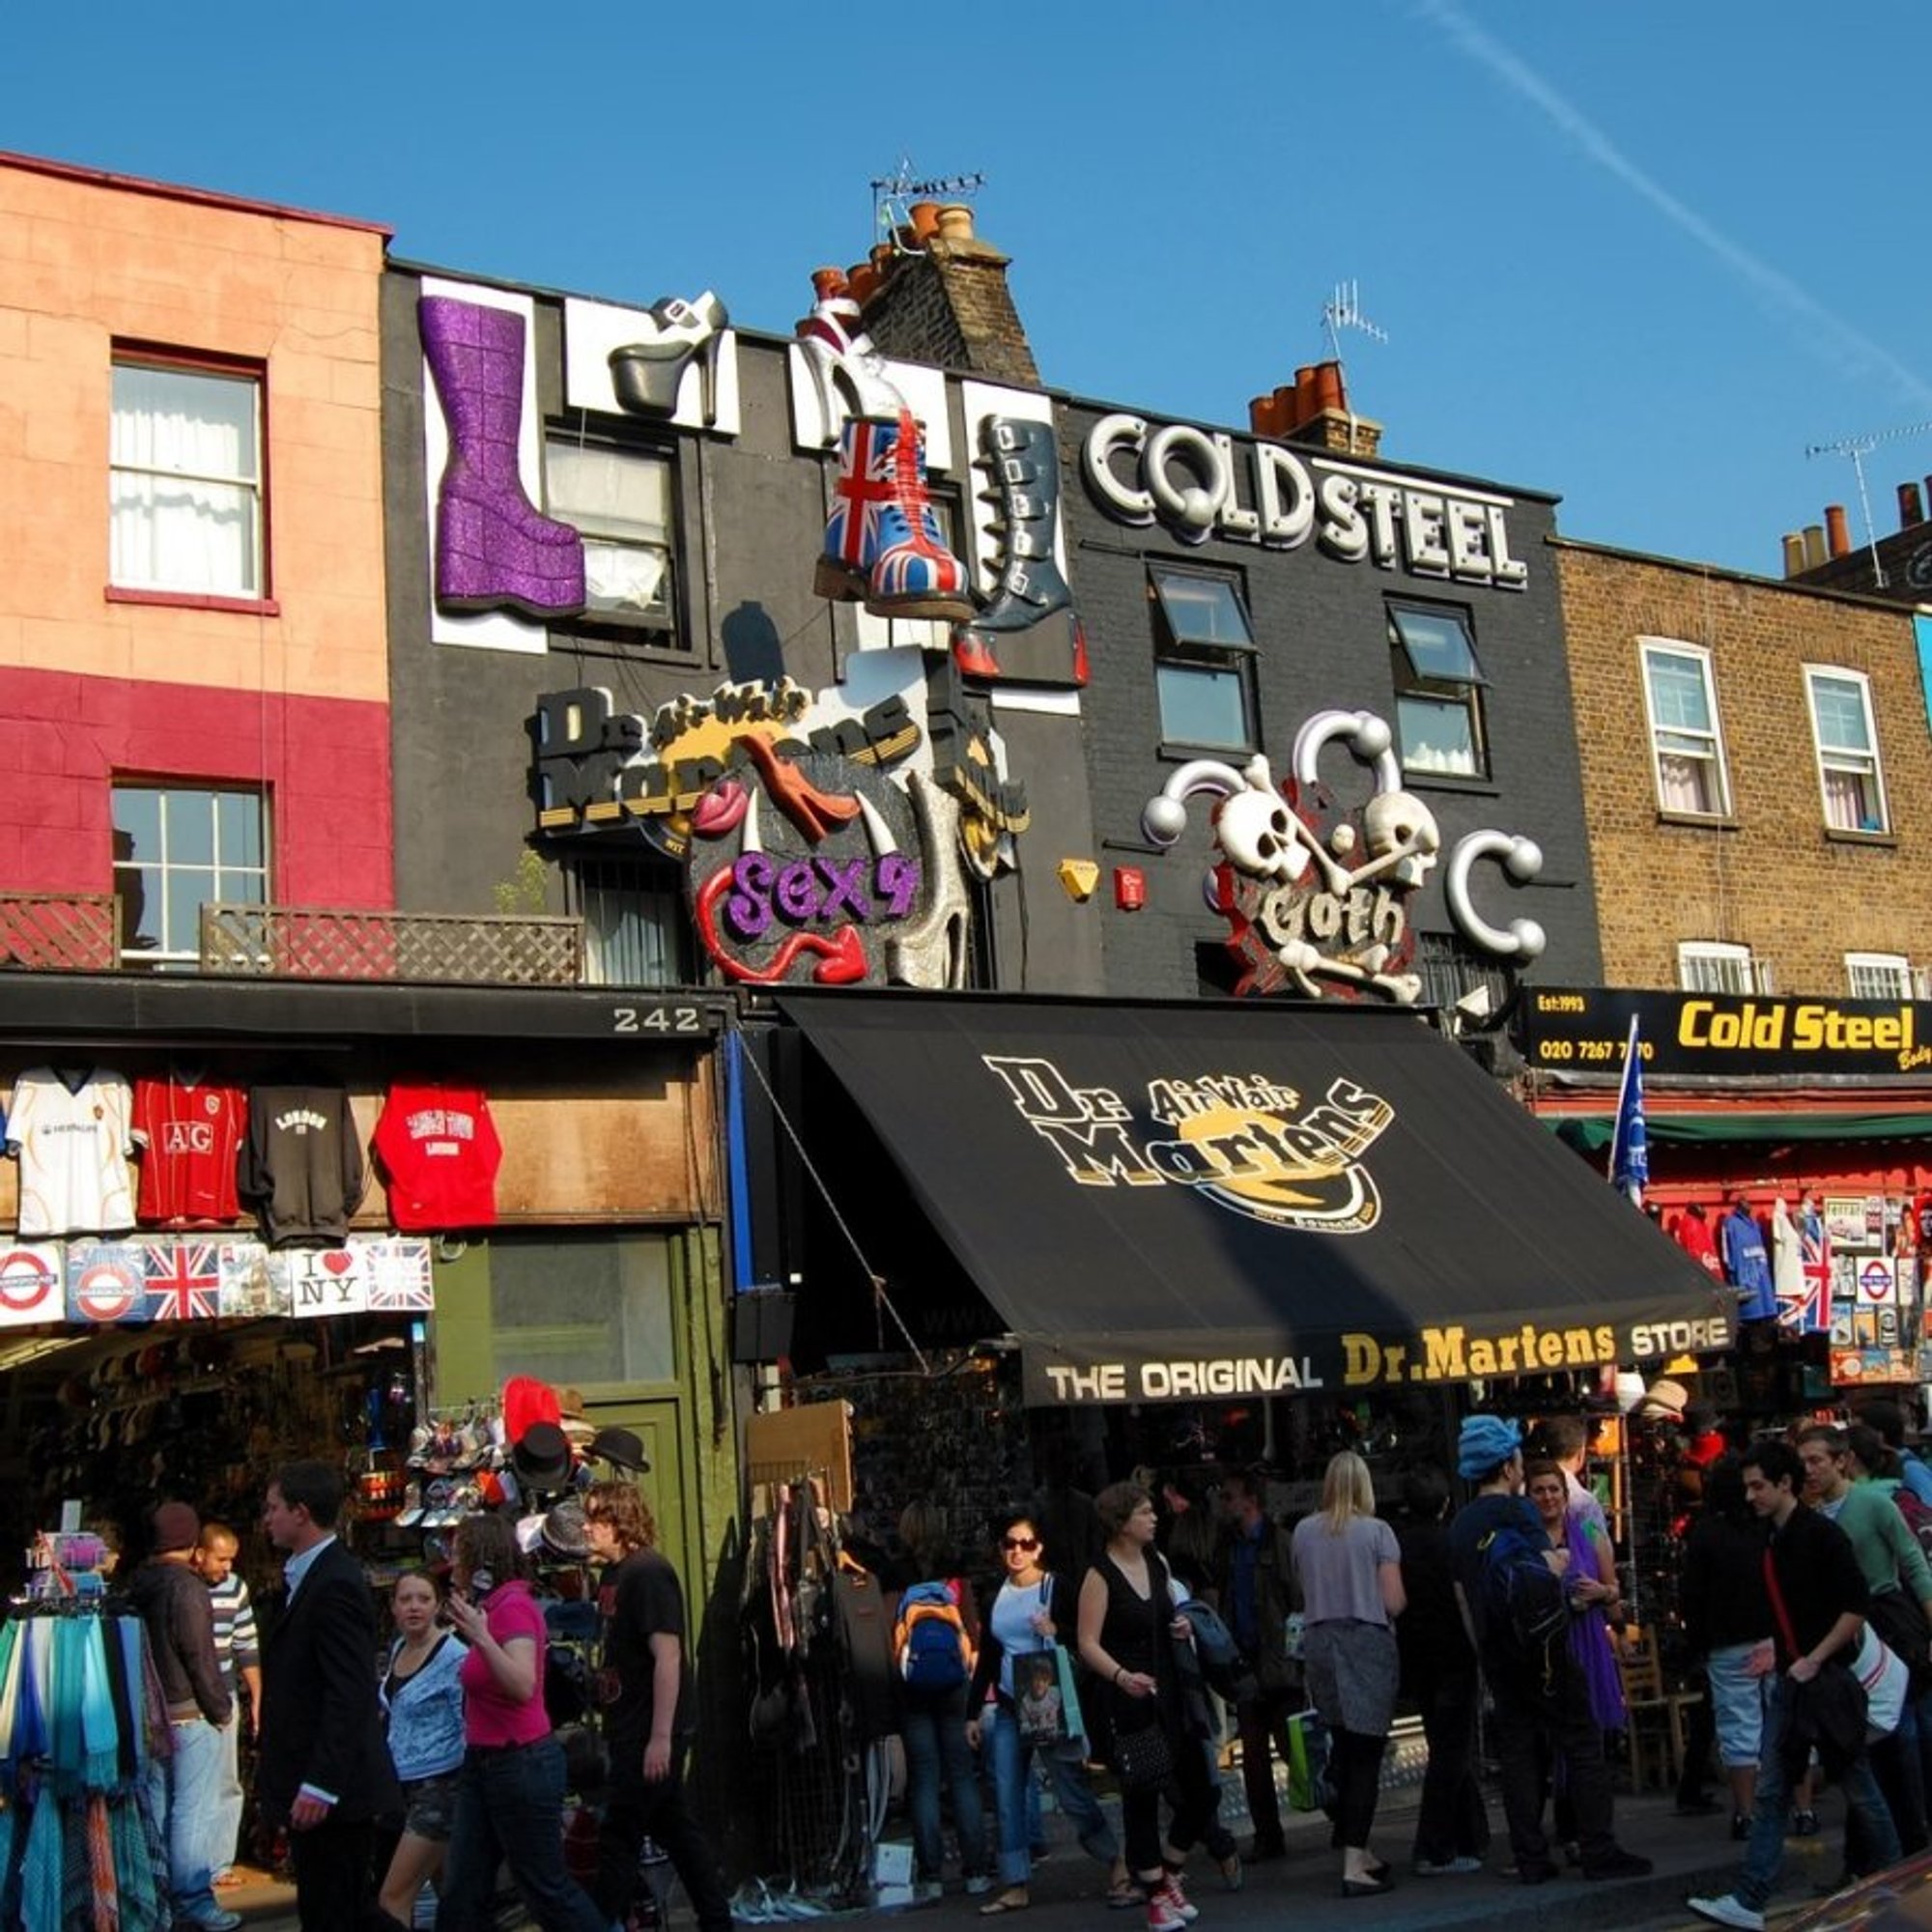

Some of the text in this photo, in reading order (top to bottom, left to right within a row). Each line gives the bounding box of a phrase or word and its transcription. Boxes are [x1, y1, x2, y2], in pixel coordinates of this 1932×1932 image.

[1083, 413, 1527, 590] COLD STEEL
[1260, 886, 1407, 947] Goth
[613, 1008, 699, 1032] 242
[1678, 1001, 1914, 1050] Cold Steel
[1540, 1039, 1654, 1061] 020 7267 770
[982, 1054, 1134, 1122] Dr.
[1149, 1075, 1303, 1125] AirWair
[1031, 1077, 1396, 1187] Martens
[302, 1254, 317, 1277] I
[298, 1277, 359, 1305] NY
[1046, 1364, 1126, 1400] THE
[1141, 1356, 1323, 1397] ORIGINAL
[1631, 1318, 1730, 1357] STORE
